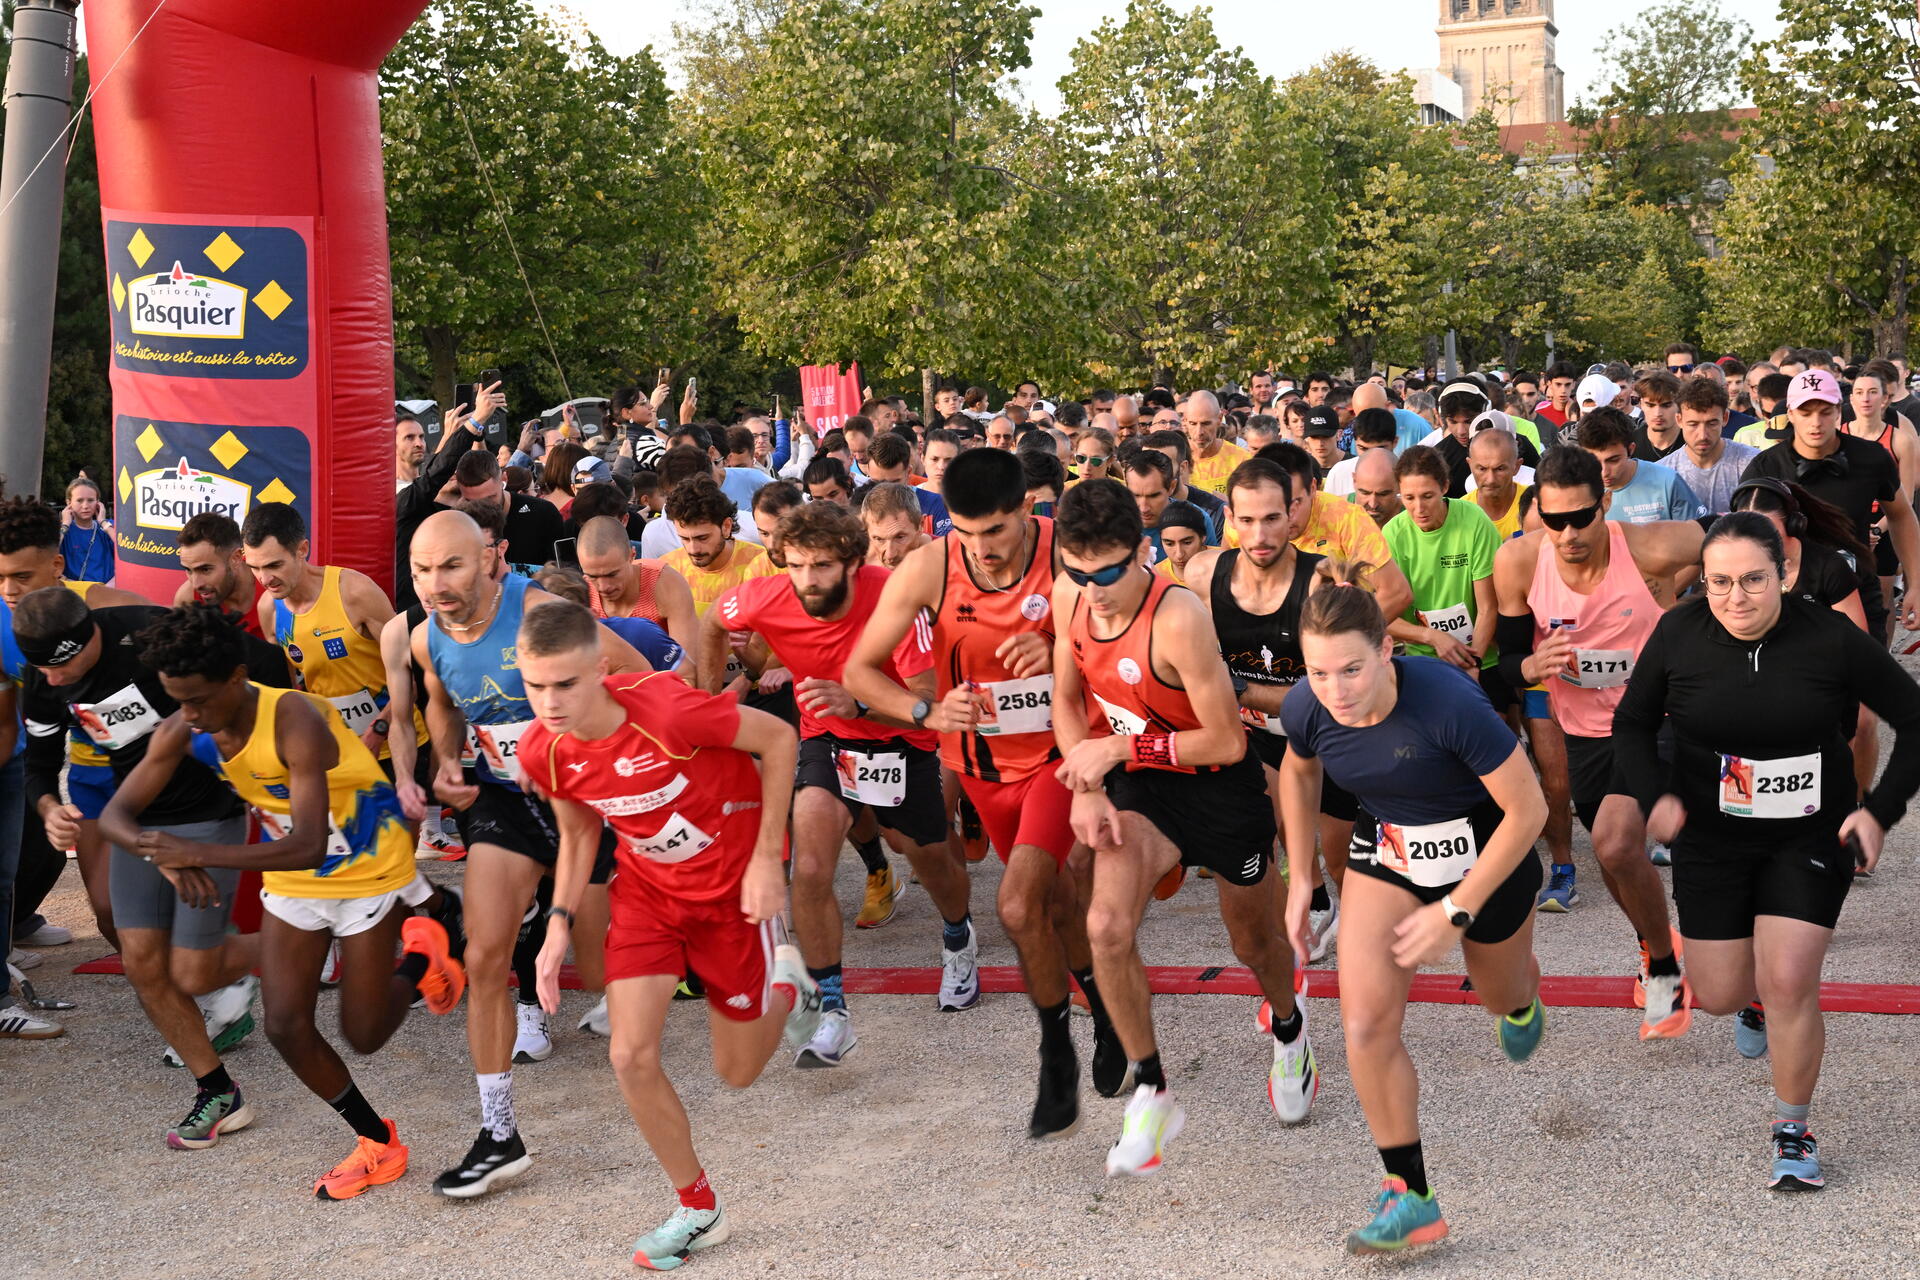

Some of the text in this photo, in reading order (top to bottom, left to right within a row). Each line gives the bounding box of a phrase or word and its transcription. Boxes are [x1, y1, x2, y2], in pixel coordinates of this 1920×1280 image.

[150, 287, 212, 299] brioche
[136, 292, 236, 330] Pasquier
[172, 350, 194, 363] est
[193, 352, 232, 365] aussi
[232, 350, 252, 365] la
[254, 351, 298, 366] vôtre
[1801, 374, 1824, 391] NY
[156, 483, 217, 494] brioche
[141, 486, 240, 524] Pasquier
[135, 532, 176, 556] histoire
[1581, 660, 1628, 673] 2171
[998, 691, 1052, 711] 2584
[101, 701, 147, 727] 2083
[339, 702, 373, 720] 710
[858, 767, 902, 784] 2478
[1757, 771, 1814, 794] 2382
[1408, 836, 1469, 860] 2030
